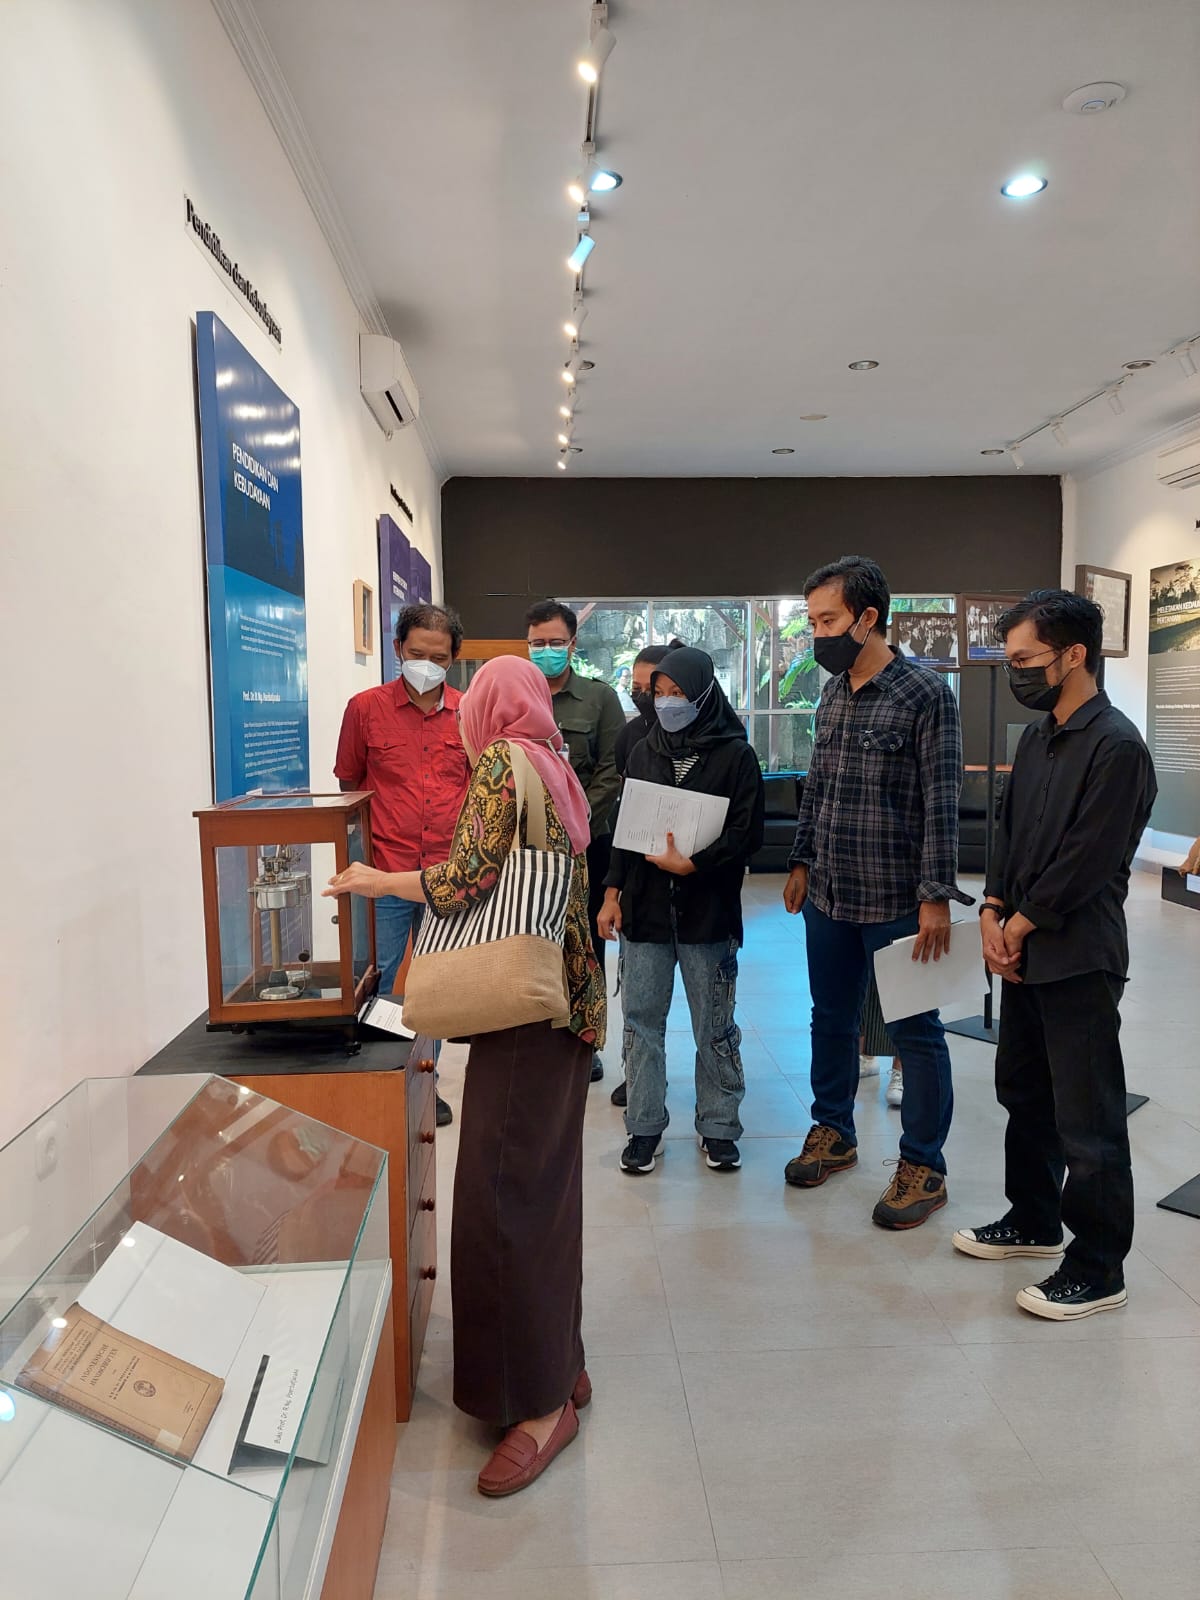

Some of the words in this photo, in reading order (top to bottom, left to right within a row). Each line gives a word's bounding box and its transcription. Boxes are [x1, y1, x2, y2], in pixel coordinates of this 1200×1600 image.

[186, 198, 231, 277] Pendidikan
[232, 263, 246, 296] dan
[232, 442, 267, 484] PENDIDIKAN
[267, 470, 279, 494] DAN
[233, 470, 271, 512] KEBUDAYAAN
